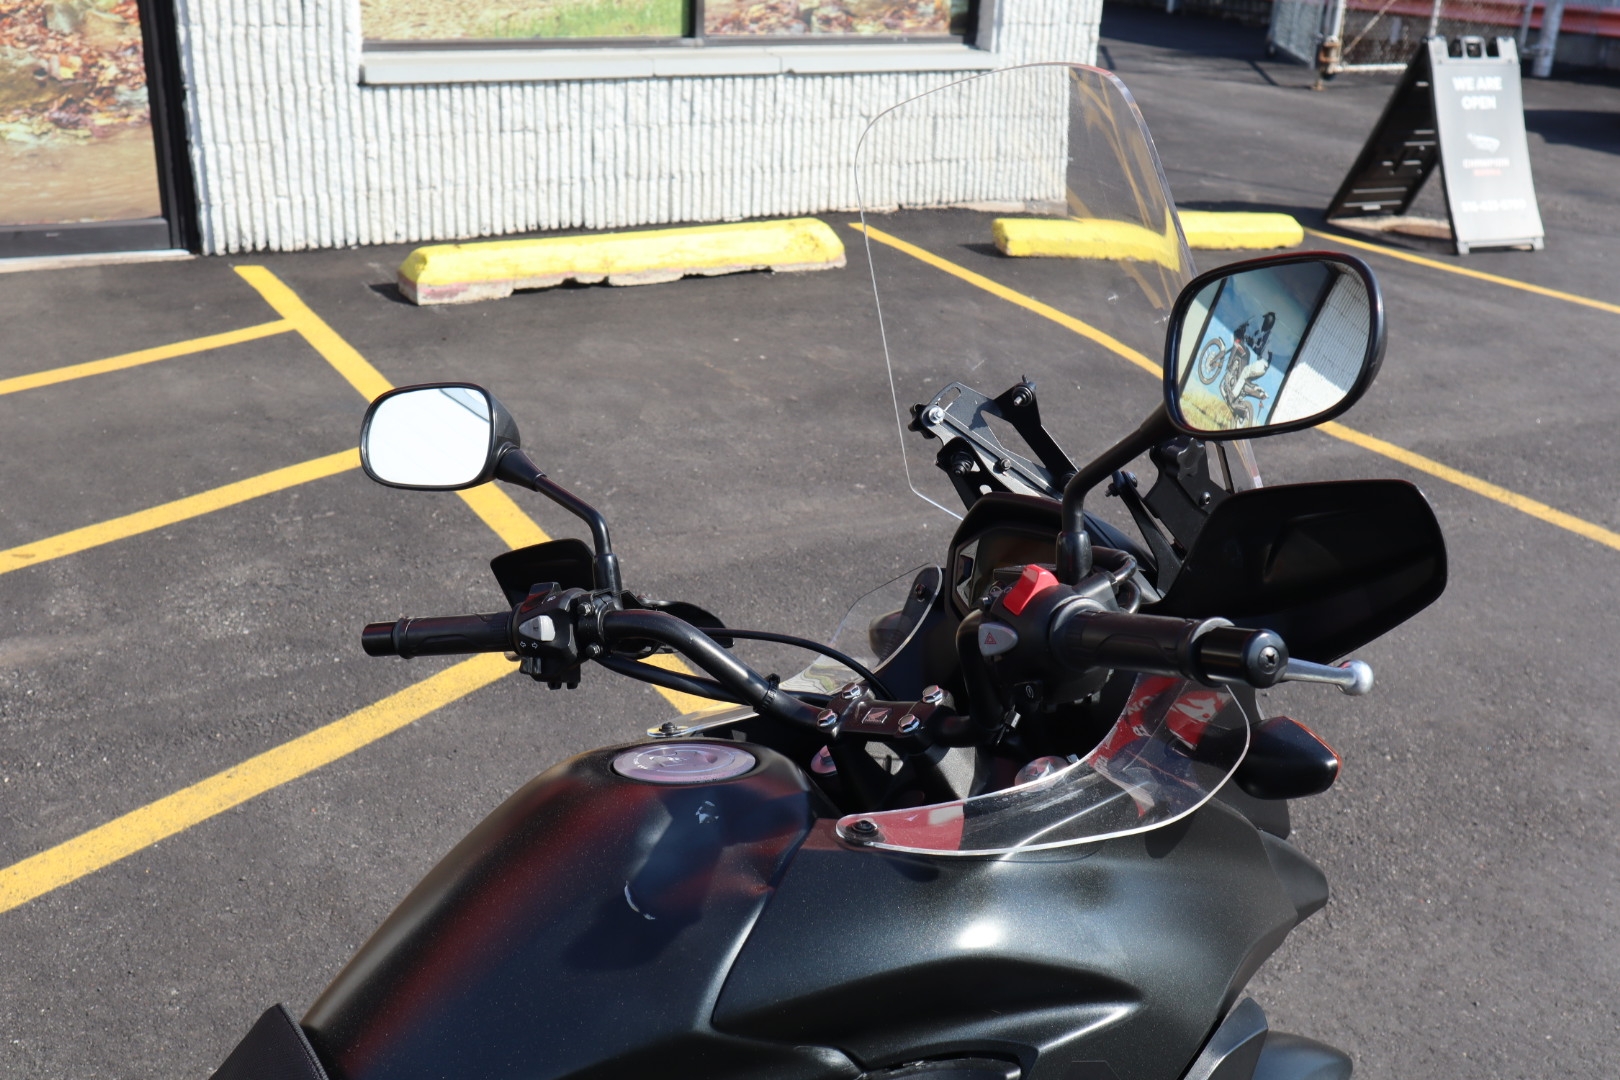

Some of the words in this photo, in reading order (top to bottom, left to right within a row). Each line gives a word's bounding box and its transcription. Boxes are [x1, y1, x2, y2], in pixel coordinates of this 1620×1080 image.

[1452, 76, 1474, 91] WE
[1475, 76, 1502, 91] ARE
[1461, 95, 1497, 110] OPEN
